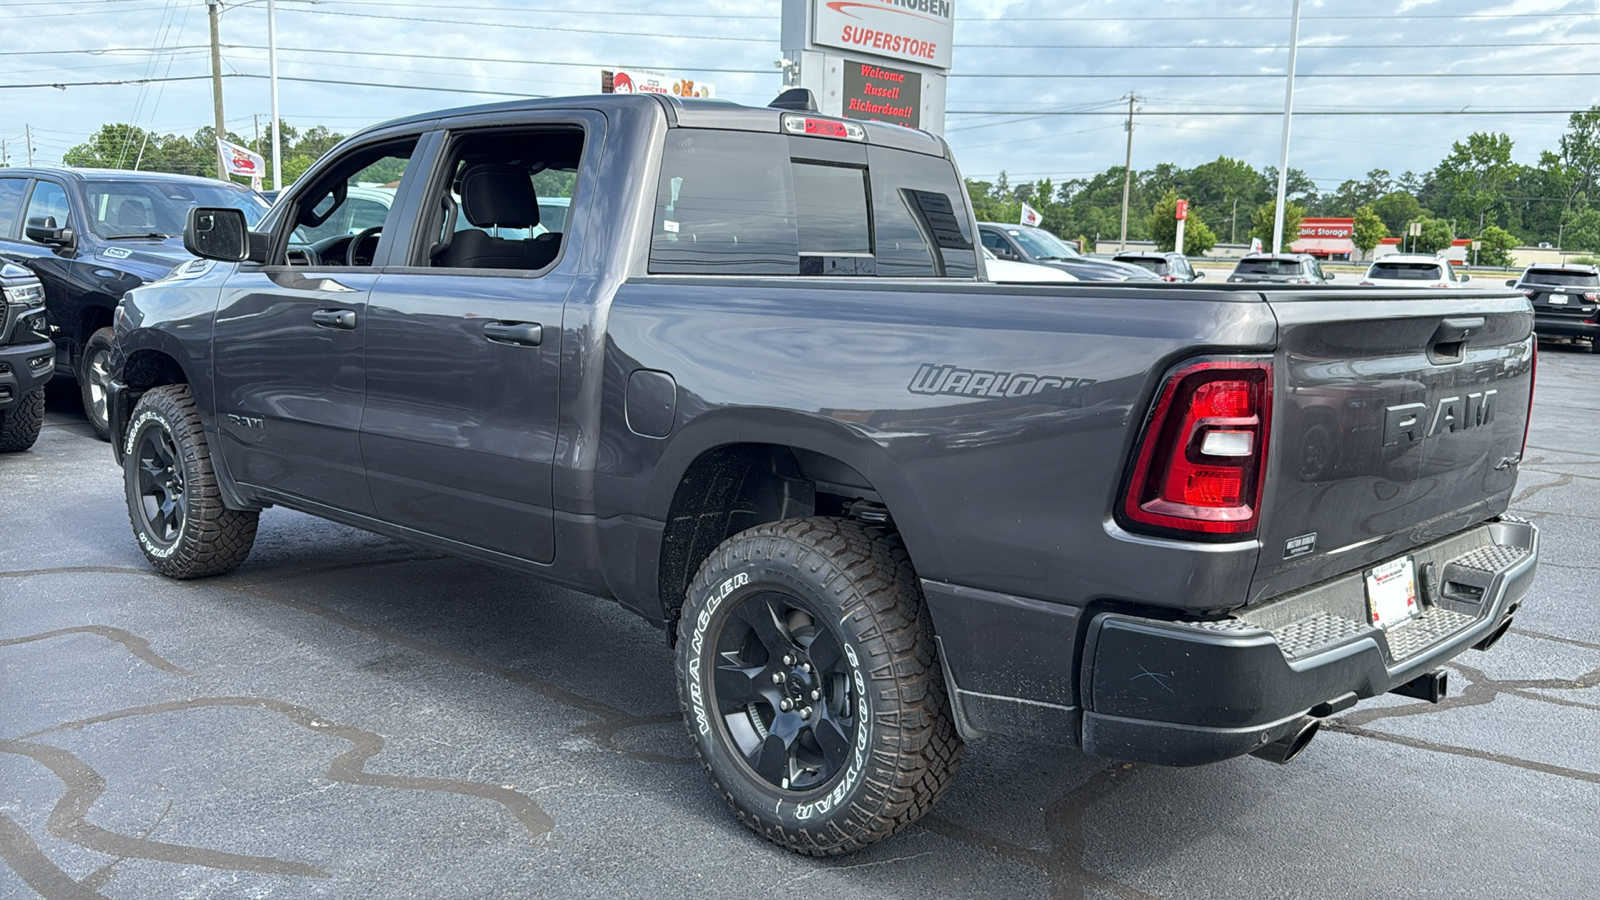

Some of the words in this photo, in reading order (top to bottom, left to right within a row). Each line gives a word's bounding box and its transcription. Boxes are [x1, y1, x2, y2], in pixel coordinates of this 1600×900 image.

[841, 25, 937, 59] SUPERSTORE
[861, 64, 904, 83] Welcome
[639, 84, 667, 94] CHICKEN
[864, 82, 900, 99] Russell
[848, 98, 913, 118] Richardson!!
[1297, 228, 1316, 236] ublic
[1317, 228, 1348, 238] Storage
[907, 362, 1098, 409] WARLOCK
[227, 413, 266, 429] RAM
[1382, 389, 1497, 448] RAM
[689, 572, 749, 735] WRANGLER
[794, 643, 868, 820] GOODYEAR
